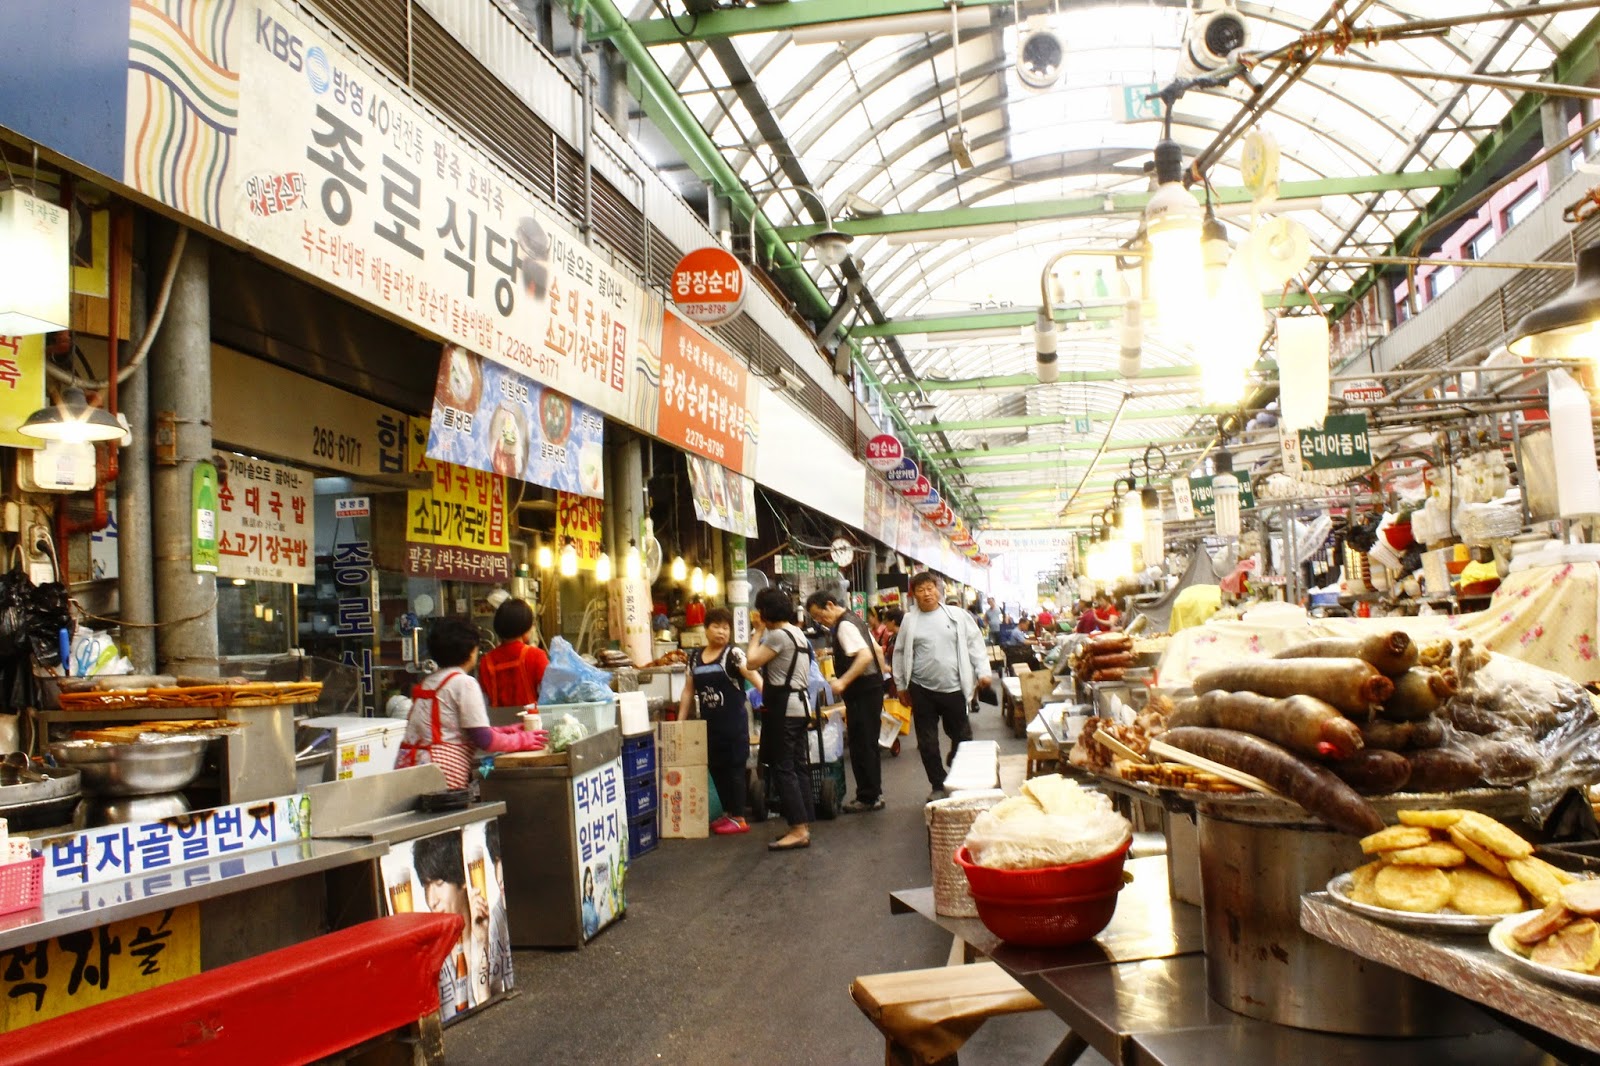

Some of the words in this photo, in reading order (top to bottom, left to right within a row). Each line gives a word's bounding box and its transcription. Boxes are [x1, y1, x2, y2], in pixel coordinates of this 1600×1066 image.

[256, 8, 303, 72] KBS
[333, 67, 364, 116] 방영
[434, 140, 462, 190] 팥죽
[467, 170, 505, 221] 호박죽
[247, 172, 309, 215] 옛날손맛
[305, 104, 524, 316] 종로식당
[301, 220, 365, 289] 녹두빈대떡
[371, 257, 415, 312] 해물파전
[418, 282, 448, 327] 왕순대
[452, 299, 494, 349] 돌솥비빔밥
[548, 232, 593, 287] 가마솥으로
[675, 269, 739, 296] 광장순대
[548, 276, 611, 346] 순대국밥
[686, 303, 727, 315] 2279-8796
[544, 318, 610, 383] 소고기장국밥
[613, 323, 626, 391] 전문
[662, 362, 745, 441] 광장순대국밥전문
[685, 428, 724, 459] 2279-8796
[1284, 439, 1296, 450] 67
[1301, 432, 1368, 457] 순대아줌마
[229, 459, 271, 482] 가마솥으로
[218, 480, 306, 525] 순대국밥
[414, 497, 488, 545] 소고기장국밥
[491, 474, 503, 545] 전문
[218, 530, 308, 568] 소고기장국밥
[408, 547, 431, 573] 팥죽
[334, 540, 376, 718] 종로식
[576, 767, 616, 815] 먹자골
[52, 801, 277, 883] 먹자골일번지
[579, 809, 619, 862] 일번지
